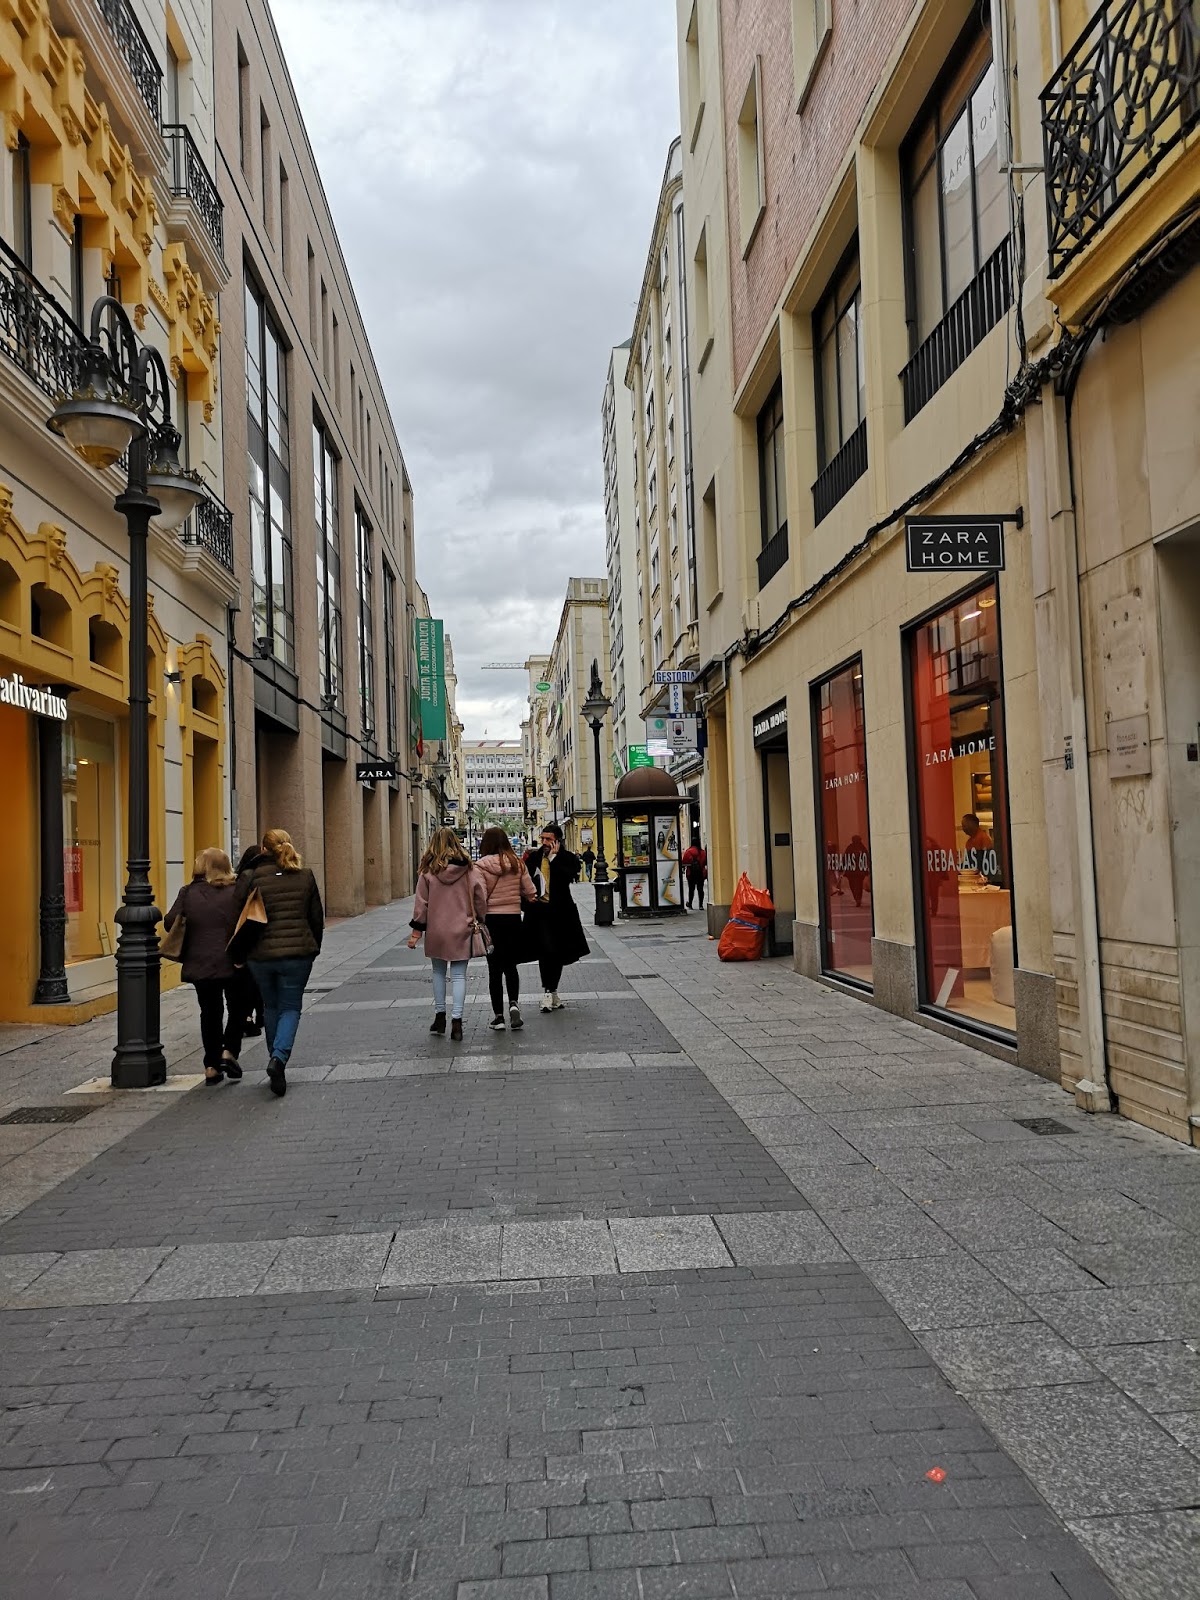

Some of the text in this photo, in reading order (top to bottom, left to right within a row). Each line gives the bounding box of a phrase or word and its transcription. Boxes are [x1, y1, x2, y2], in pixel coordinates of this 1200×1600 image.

[922, 531, 988, 545] ZARA
[922, 551, 990, 564] HOME
[421, 664, 430, 674] DE
[0, 672, 68, 721] adivarius
[421, 677, 431, 702] JUNTA
[754, 719, 770, 737] ZARA
[925, 736, 997, 766] ZARA HOME
[358, 770, 393, 778] ZARA
[825, 771, 865, 790] ZARA HOME
[827, 851, 869, 872] REBAJAS 60
[927, 847, 978, 872] REBAJAS
